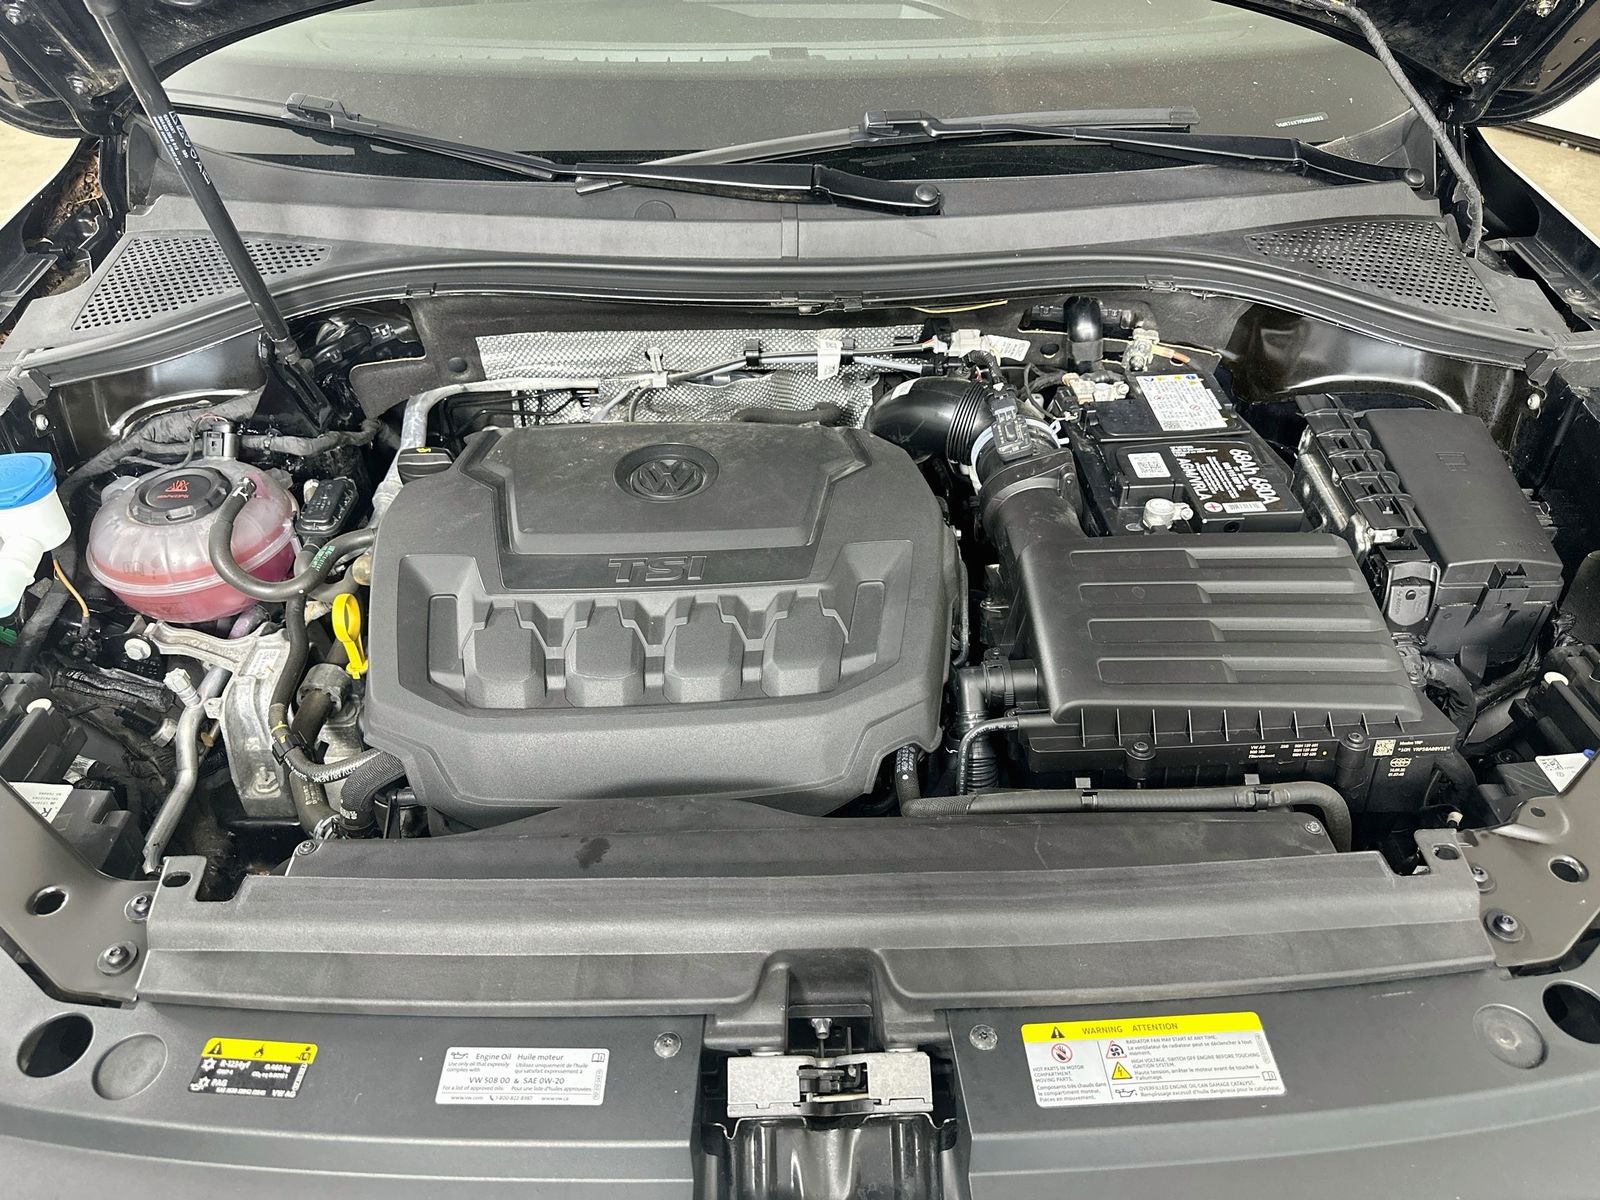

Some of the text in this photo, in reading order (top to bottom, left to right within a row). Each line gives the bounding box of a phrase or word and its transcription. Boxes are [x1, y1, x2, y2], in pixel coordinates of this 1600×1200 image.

[1178, 458, 1212, 501] AGM/VRLA
[1229, 449, 1260, 476] 68Ah
[1249, 477, 1281, 504] 680A
[608, 556, 707, 583] TSI
[1082, 1022, 1178, 1034] WARNING ATTENTION
[476, 1053, 500, 1061] Engine
